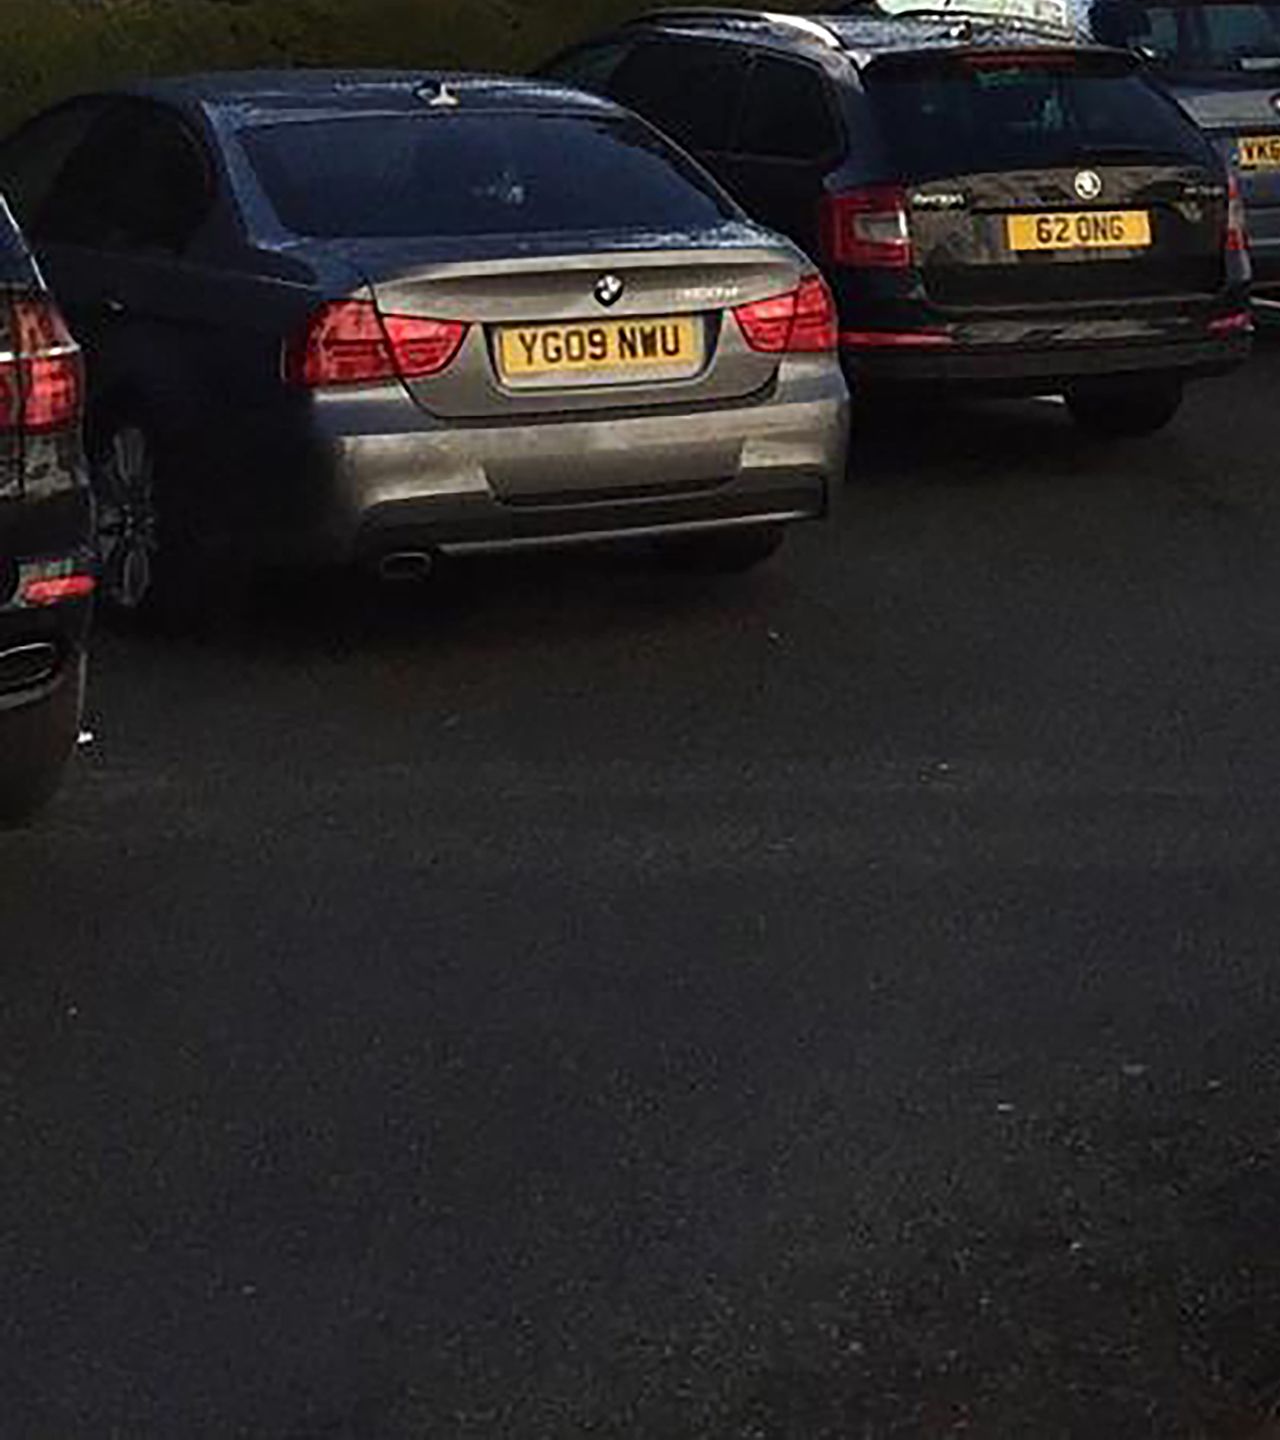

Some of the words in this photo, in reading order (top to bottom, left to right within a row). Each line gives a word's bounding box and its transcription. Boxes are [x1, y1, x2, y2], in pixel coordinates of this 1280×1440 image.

[1036, 216, 1072, 244] 62
[1076, 214, 1125, 242] ONG
[518, 327, 608, 365] YG09
[617, 324, 680, 360] NWU
